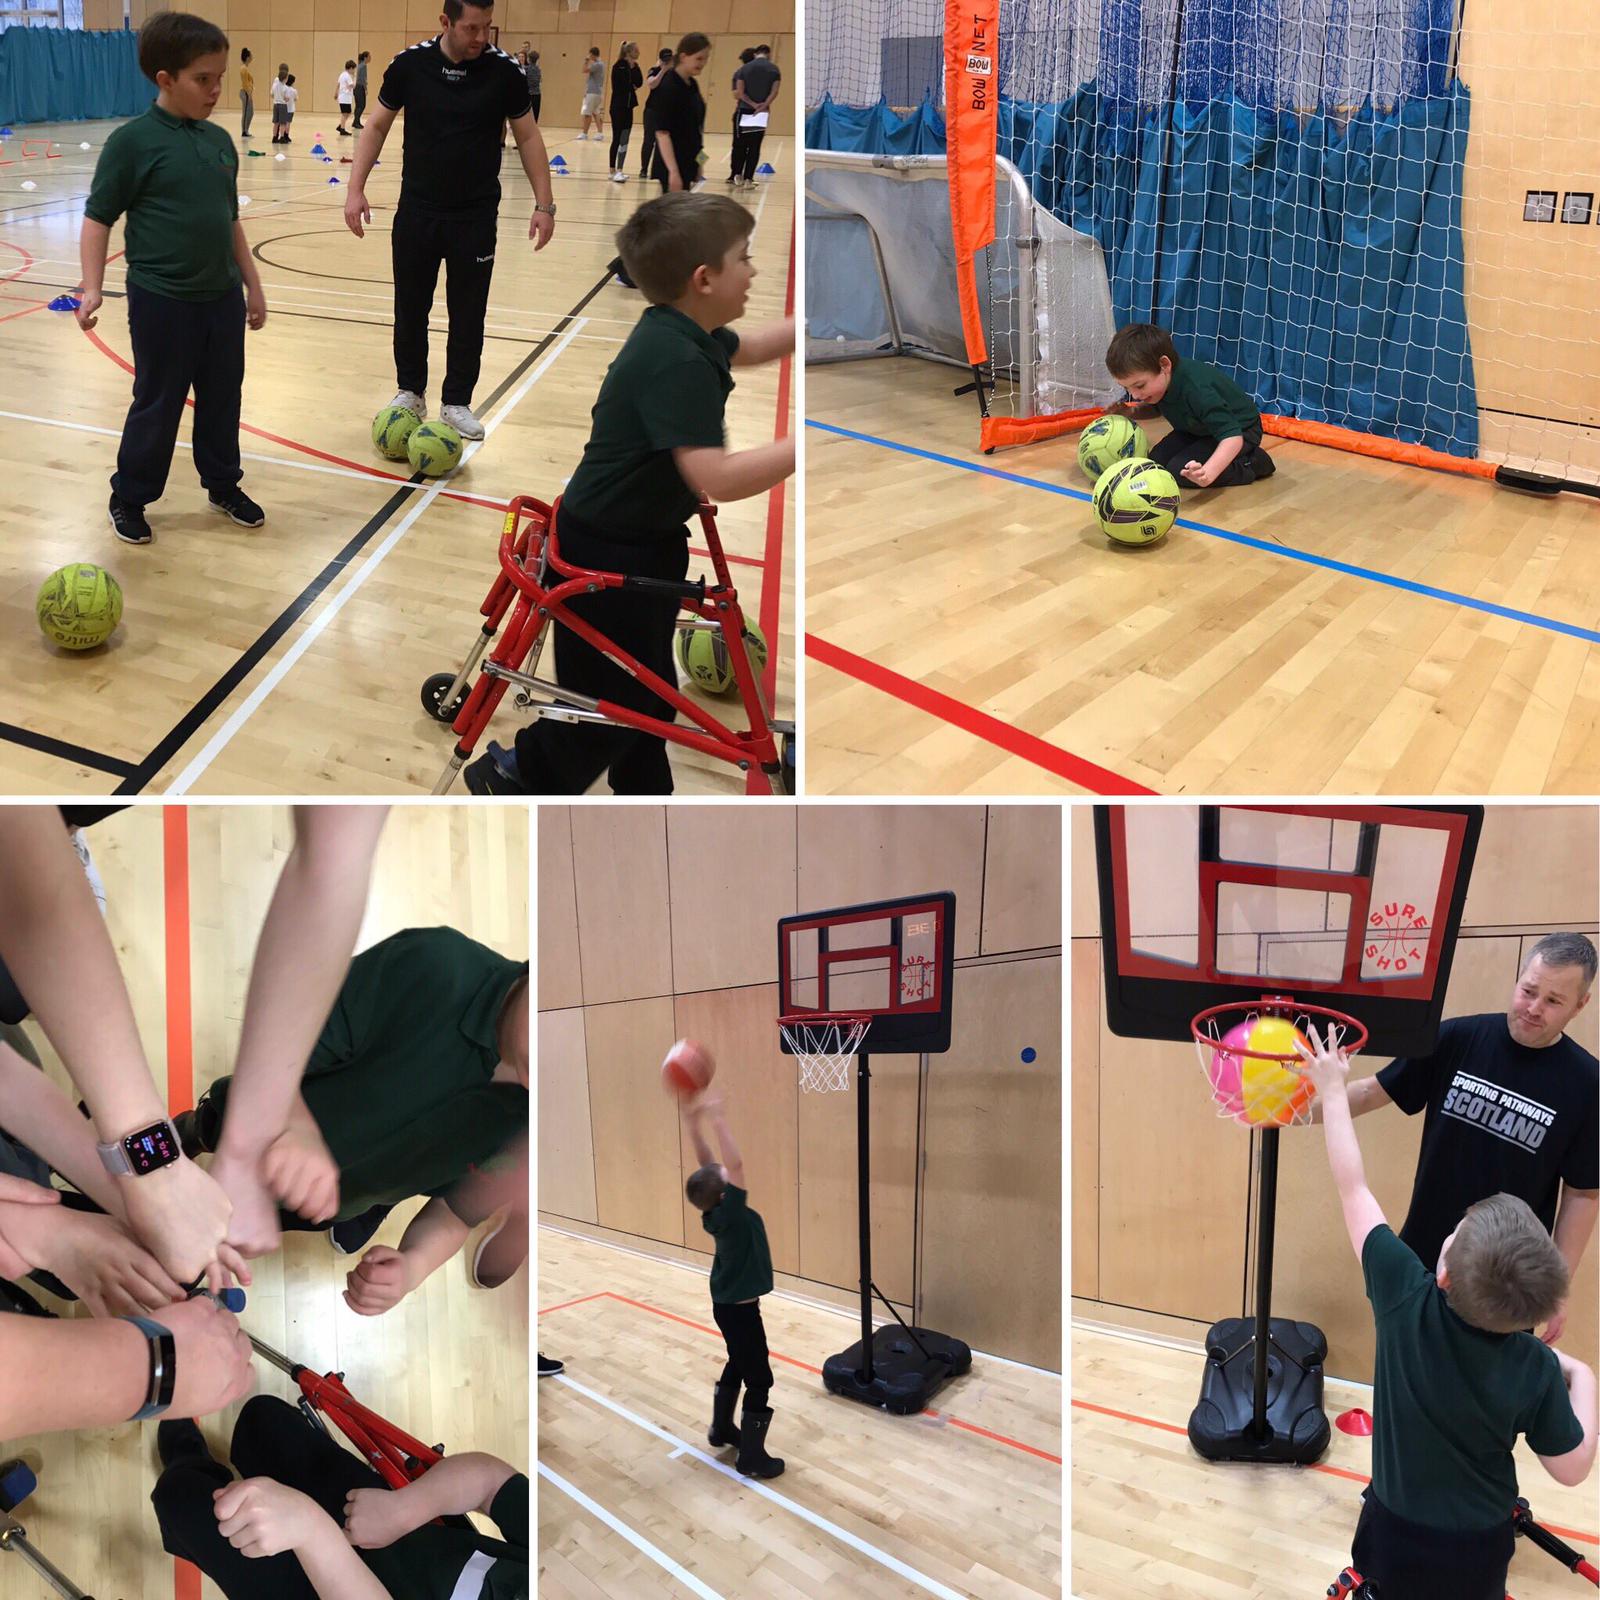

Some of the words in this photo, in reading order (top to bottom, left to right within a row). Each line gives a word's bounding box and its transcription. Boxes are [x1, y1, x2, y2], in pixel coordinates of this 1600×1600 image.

[972, 14, 987, 52] NET
[968, 58, 989, 70] BOW
[972, 78, 986, 110] BOW
[55, 631, 100, 646] mitre
[1370, 902, 1428, 928] SURE
[1365, 944, 1421, 971] SHOT
[900, 980, 931, 997] SHOT
[1451, 1075, 1499, 1102] SPORTING
[1499, 1094, 1555, 1127] PATHWAYS
[1443, 1087, 1547, 1149] SCOTLAND
